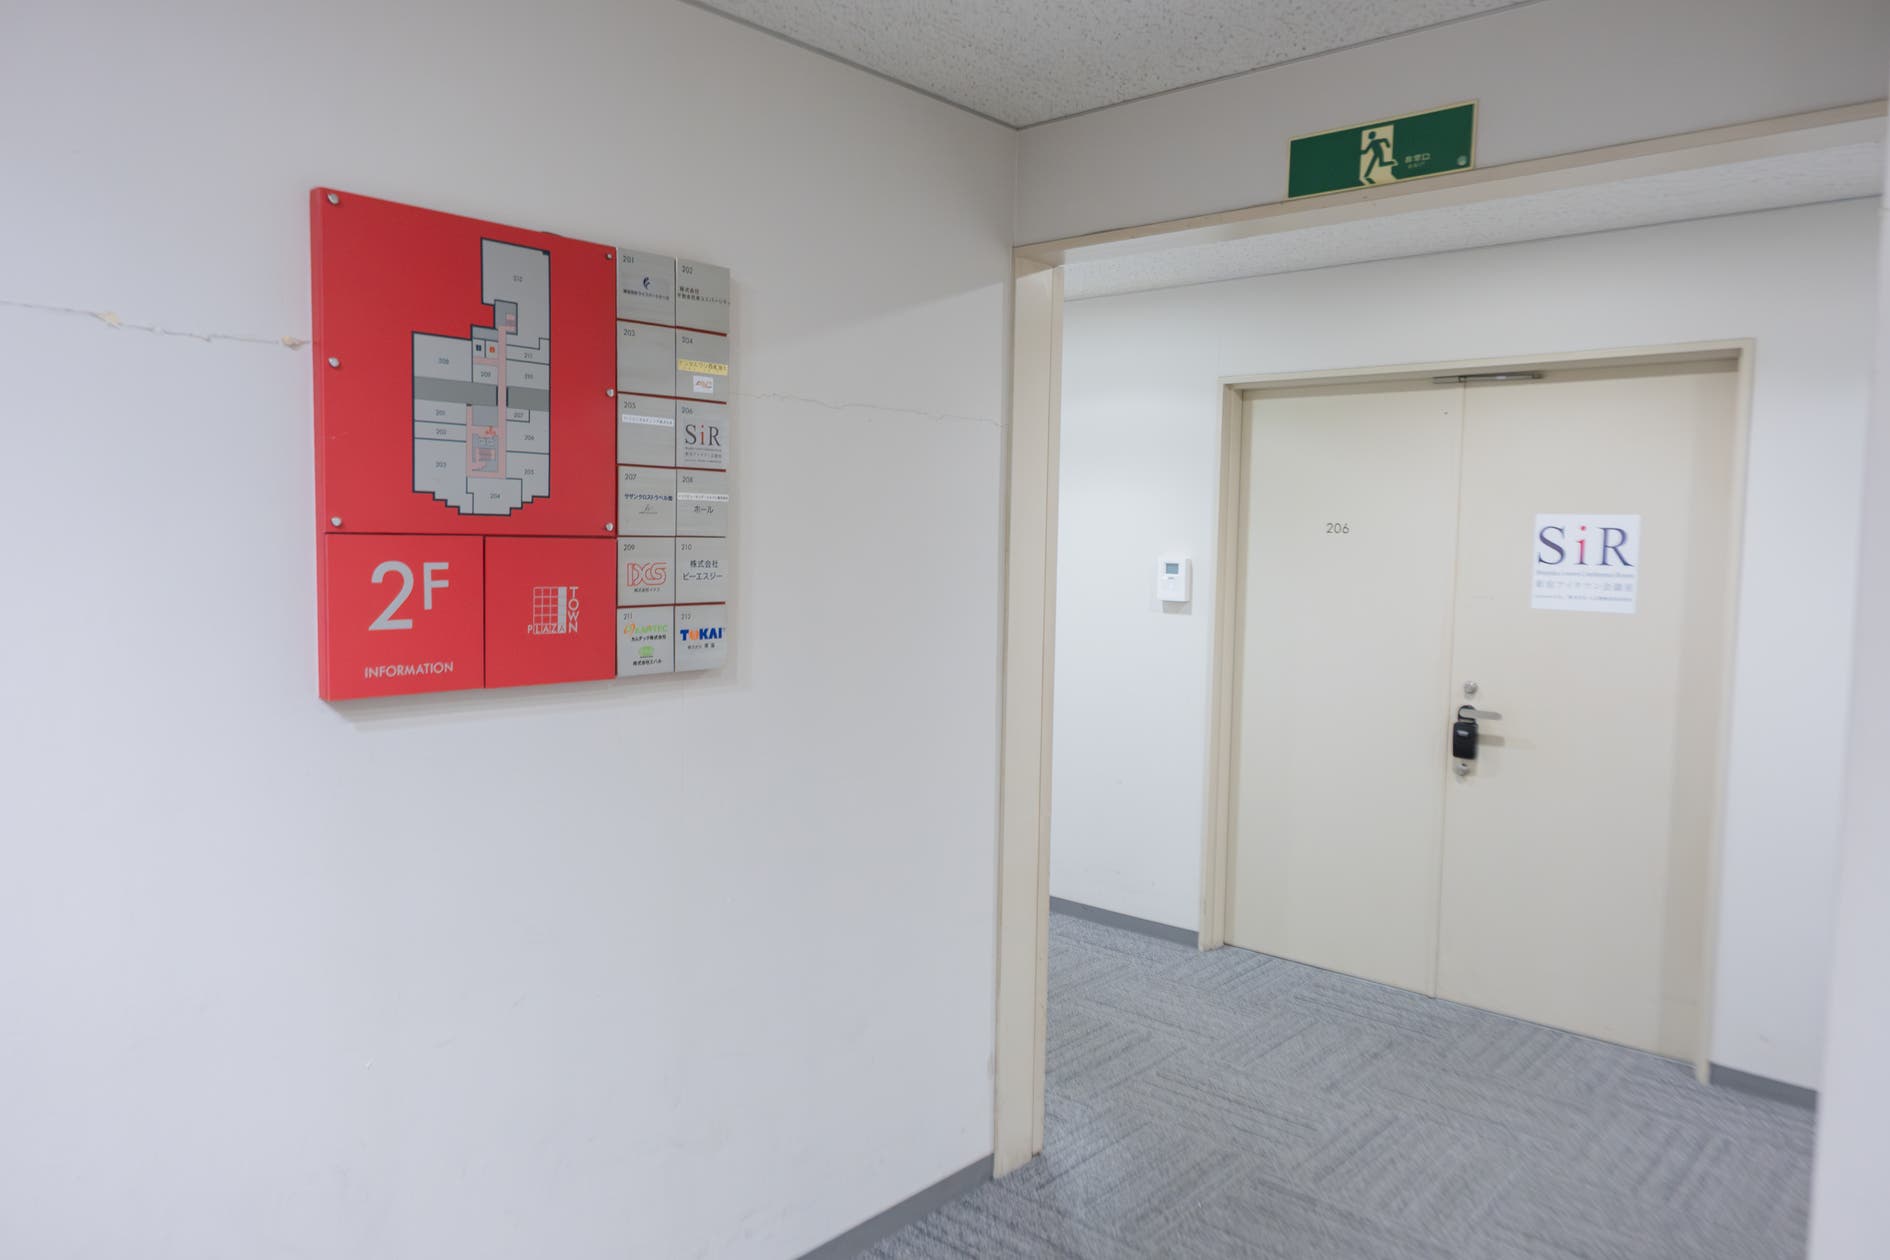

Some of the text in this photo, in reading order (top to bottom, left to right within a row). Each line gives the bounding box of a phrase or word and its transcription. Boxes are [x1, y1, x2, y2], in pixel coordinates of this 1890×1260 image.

[623, 255, 635, 263] 201
[682, 265, 693, 274] 202
[623, 328, 636, 337] 203
[681, 336, 693, 344] 204
[624, 401, 636, 409] 205
[681, 406, 693, 414] 206
[684, 424, 721, 446] SiR
[435, 460, 447, 468] 203
[624, 473, 637, 481] 207
[490, 492, 501, 500] 204
[1326, 523, 1350, 534] 206
[1537, 526, 1635, 567] SiR
[690, 560, 718, 569] 株式会社
[683, 572, 723, 581] ビーエスジー
[368, 560, 449, 631] 2F
[568, 586, 580, 633] TOWN
[527, 624, 567, 634] PLAZA
[364, 661, 454, 679] INFORMATION
